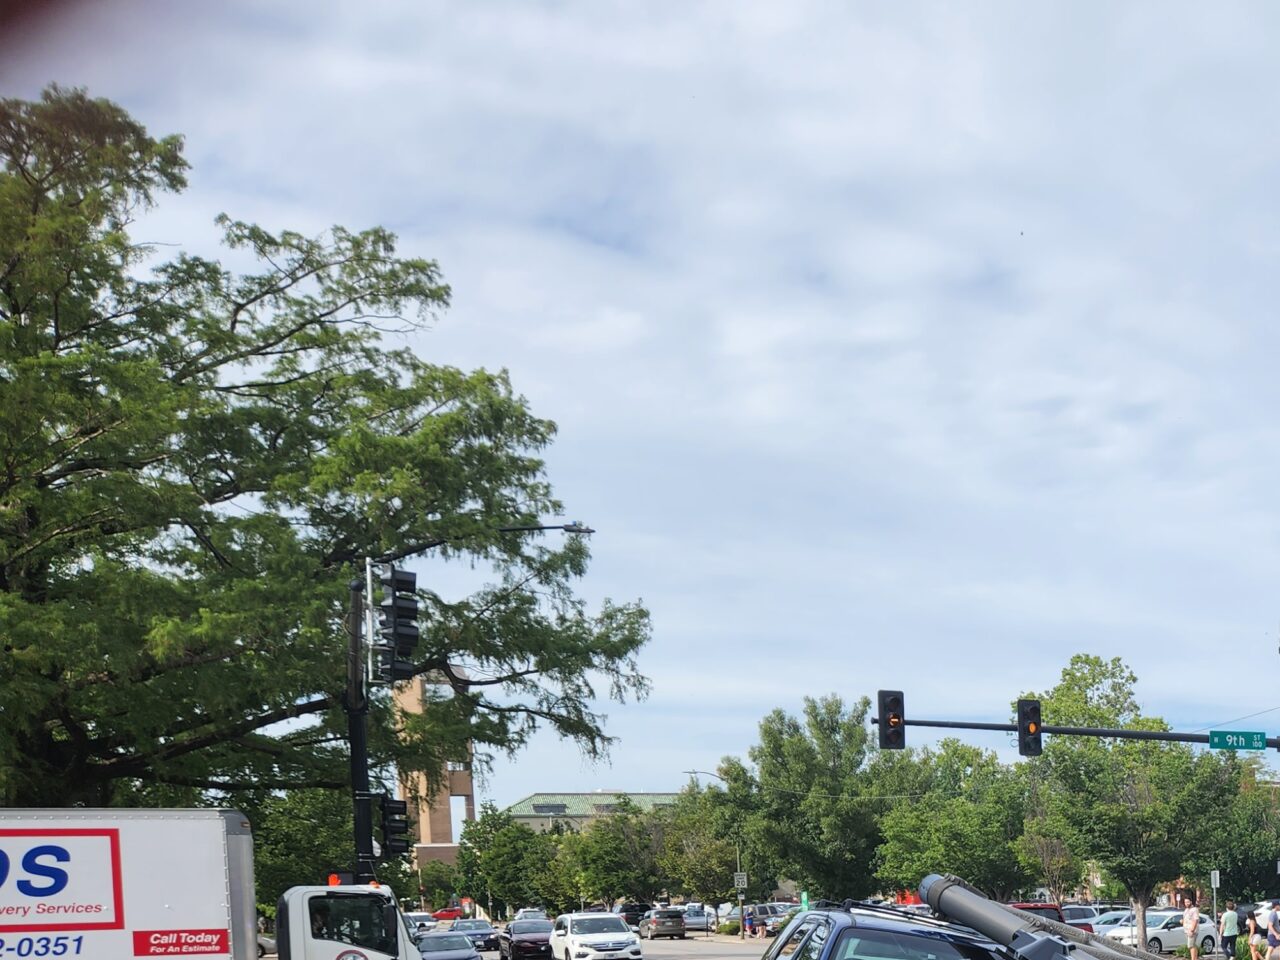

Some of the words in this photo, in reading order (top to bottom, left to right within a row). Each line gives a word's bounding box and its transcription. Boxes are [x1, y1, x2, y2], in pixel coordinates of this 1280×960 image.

[1226, 734, 1245, 746] 9th
[36, 903, 103, 915] Services
[150, 933, 178, 944] Call
[179, 932, 221, 945] Today
[181, 945, 221, 953] Estimate
